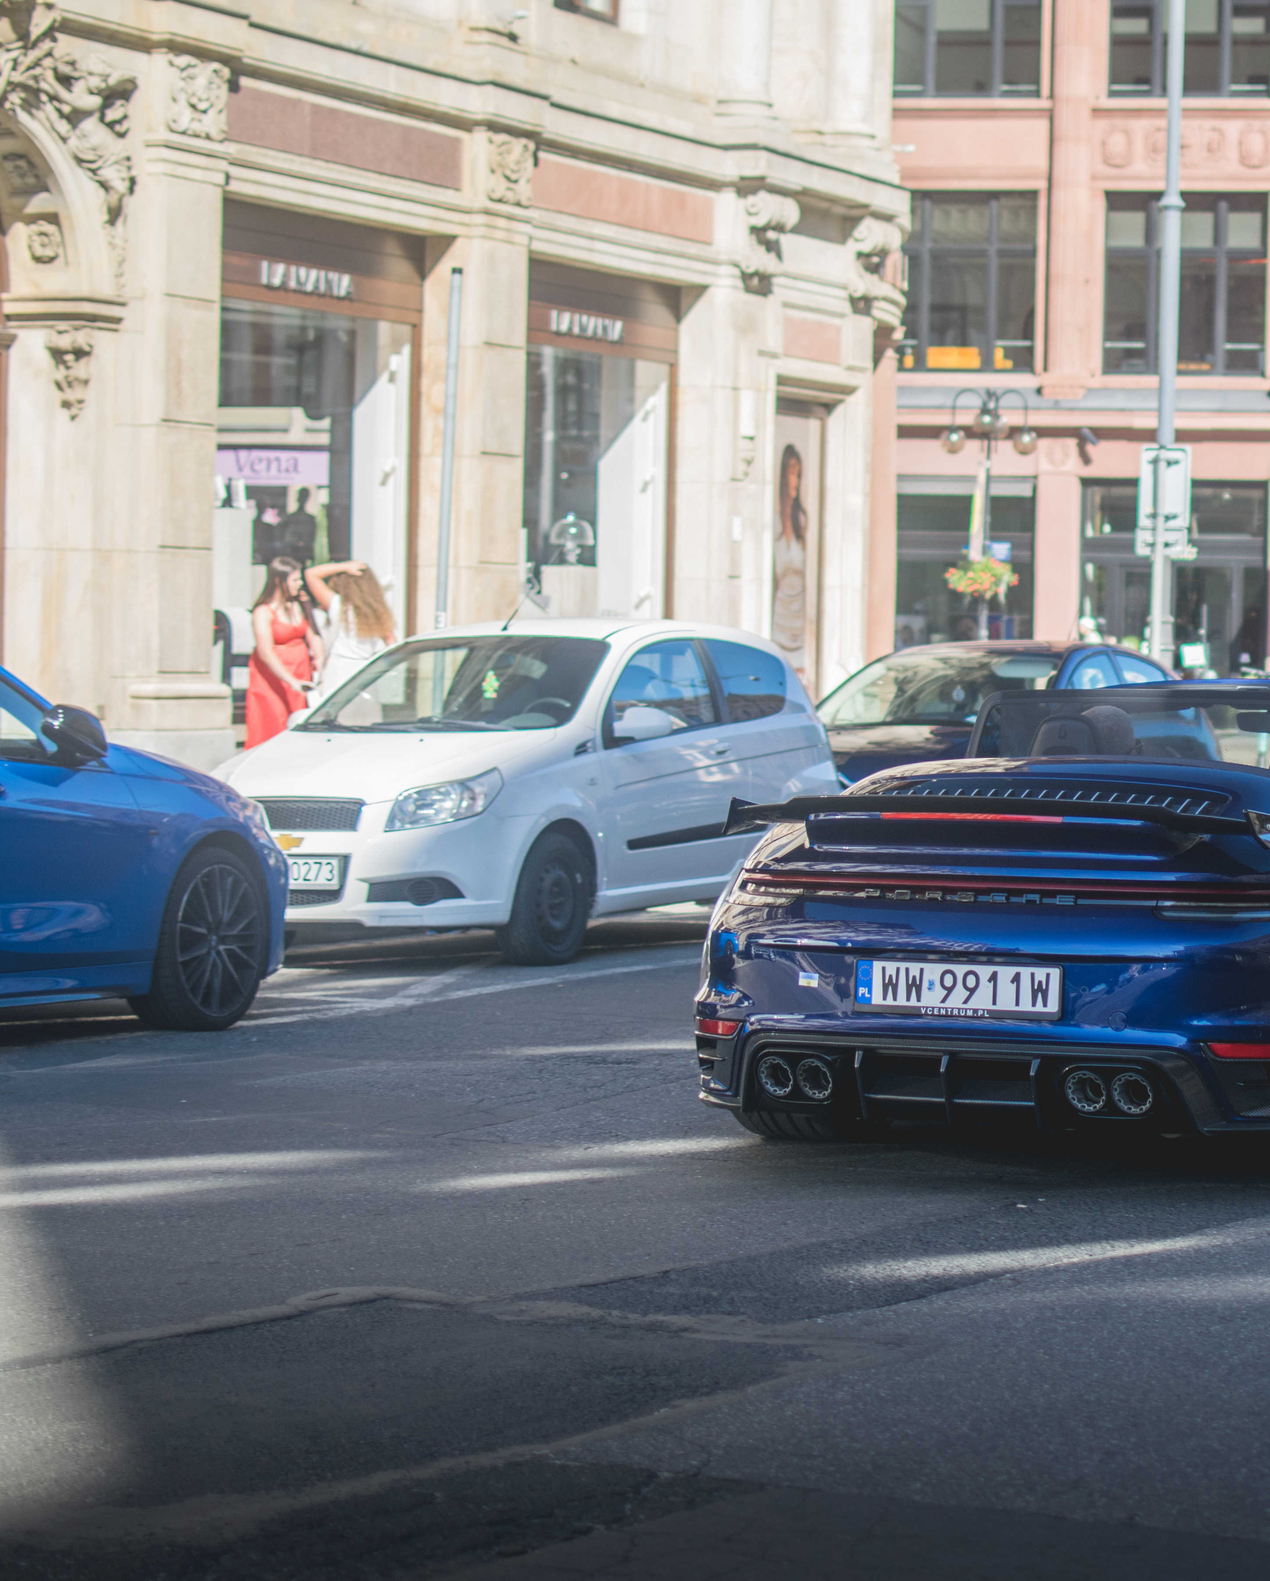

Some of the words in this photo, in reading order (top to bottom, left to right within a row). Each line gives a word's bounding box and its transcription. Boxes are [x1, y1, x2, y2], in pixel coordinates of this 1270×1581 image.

[233, 449, 299, 473] Vena
[290, 861, 334, 882] 0273
[864, 888, 1077, 905] PORSCHE
[858, 987, 870, 997] PL
[881, 966, 924, 1002] WW
[939, 969, 1051, 1008] 9911W
[920, 1007, 990, 1017] VCENTRUM.PL
